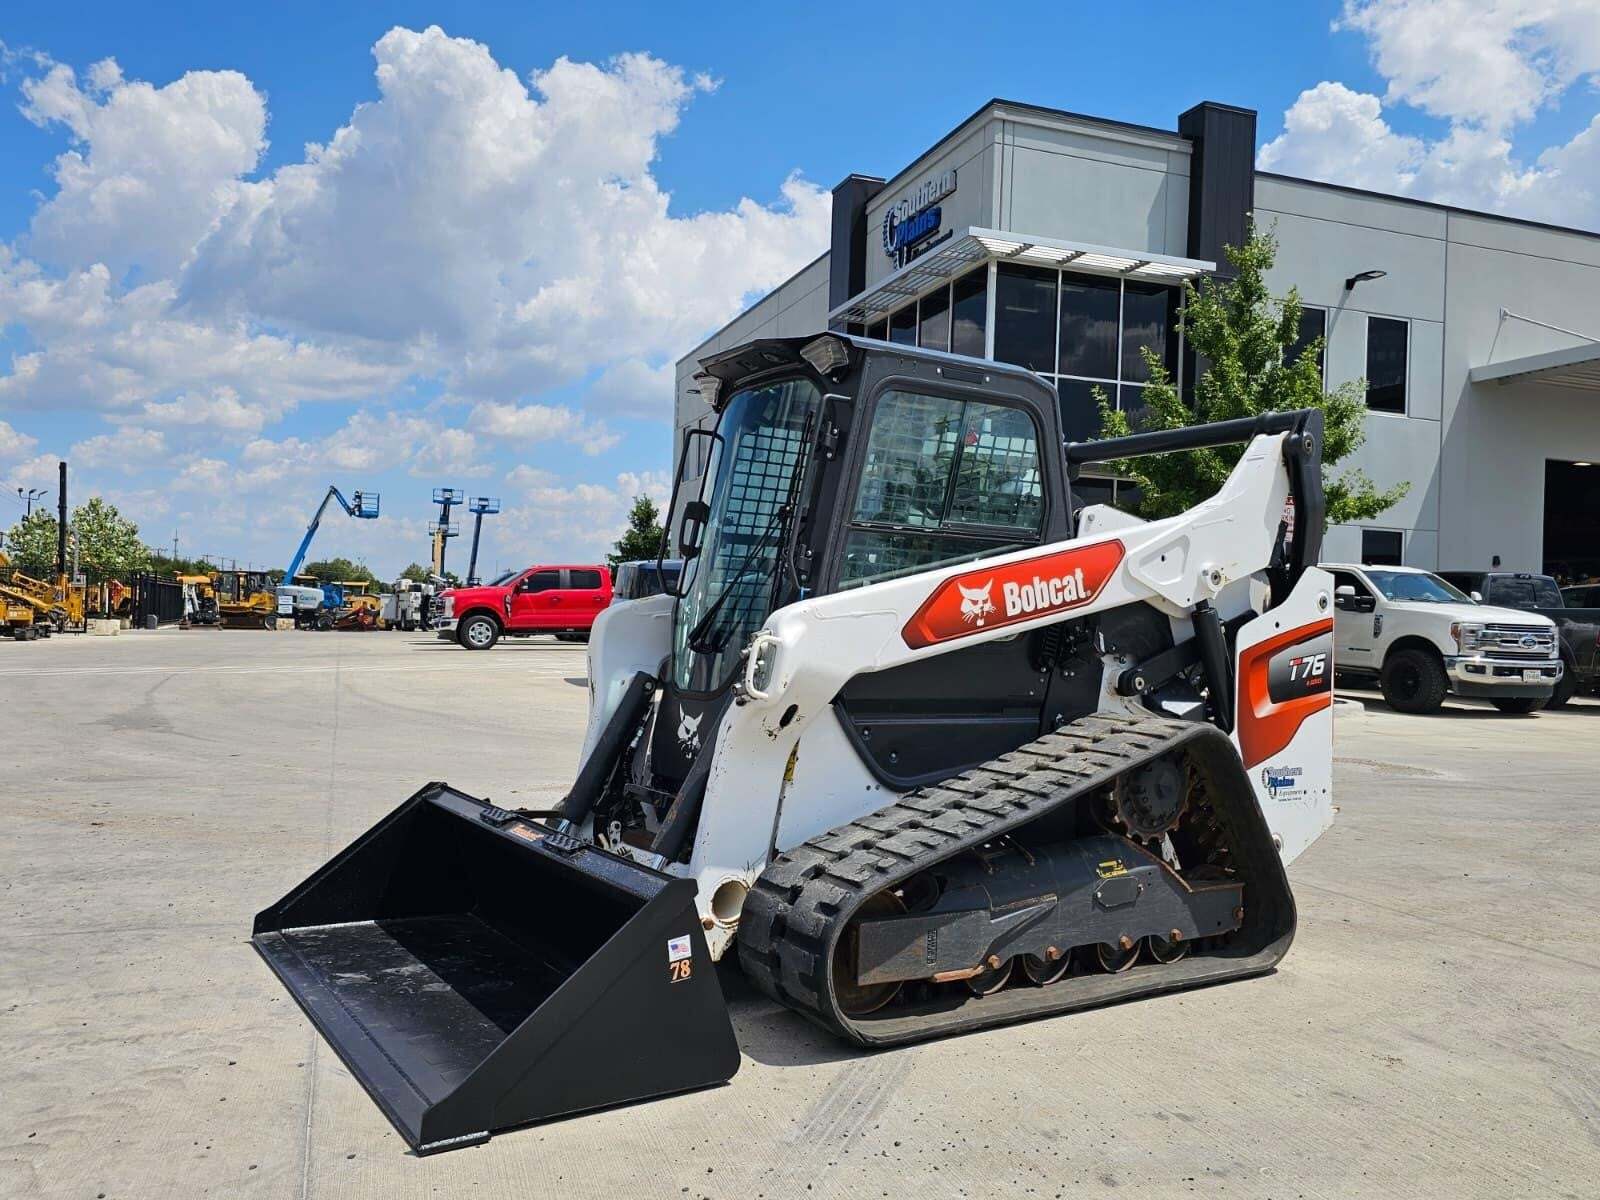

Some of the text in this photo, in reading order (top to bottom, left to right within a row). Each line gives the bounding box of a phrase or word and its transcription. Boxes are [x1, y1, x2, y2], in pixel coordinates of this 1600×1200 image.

[894, 170, 957, 225] Southern
[1003, 567, 1087, 616] Bobcat
[1289, 653, 1326, 681] T76
[669, 959, 691, 978] 78
